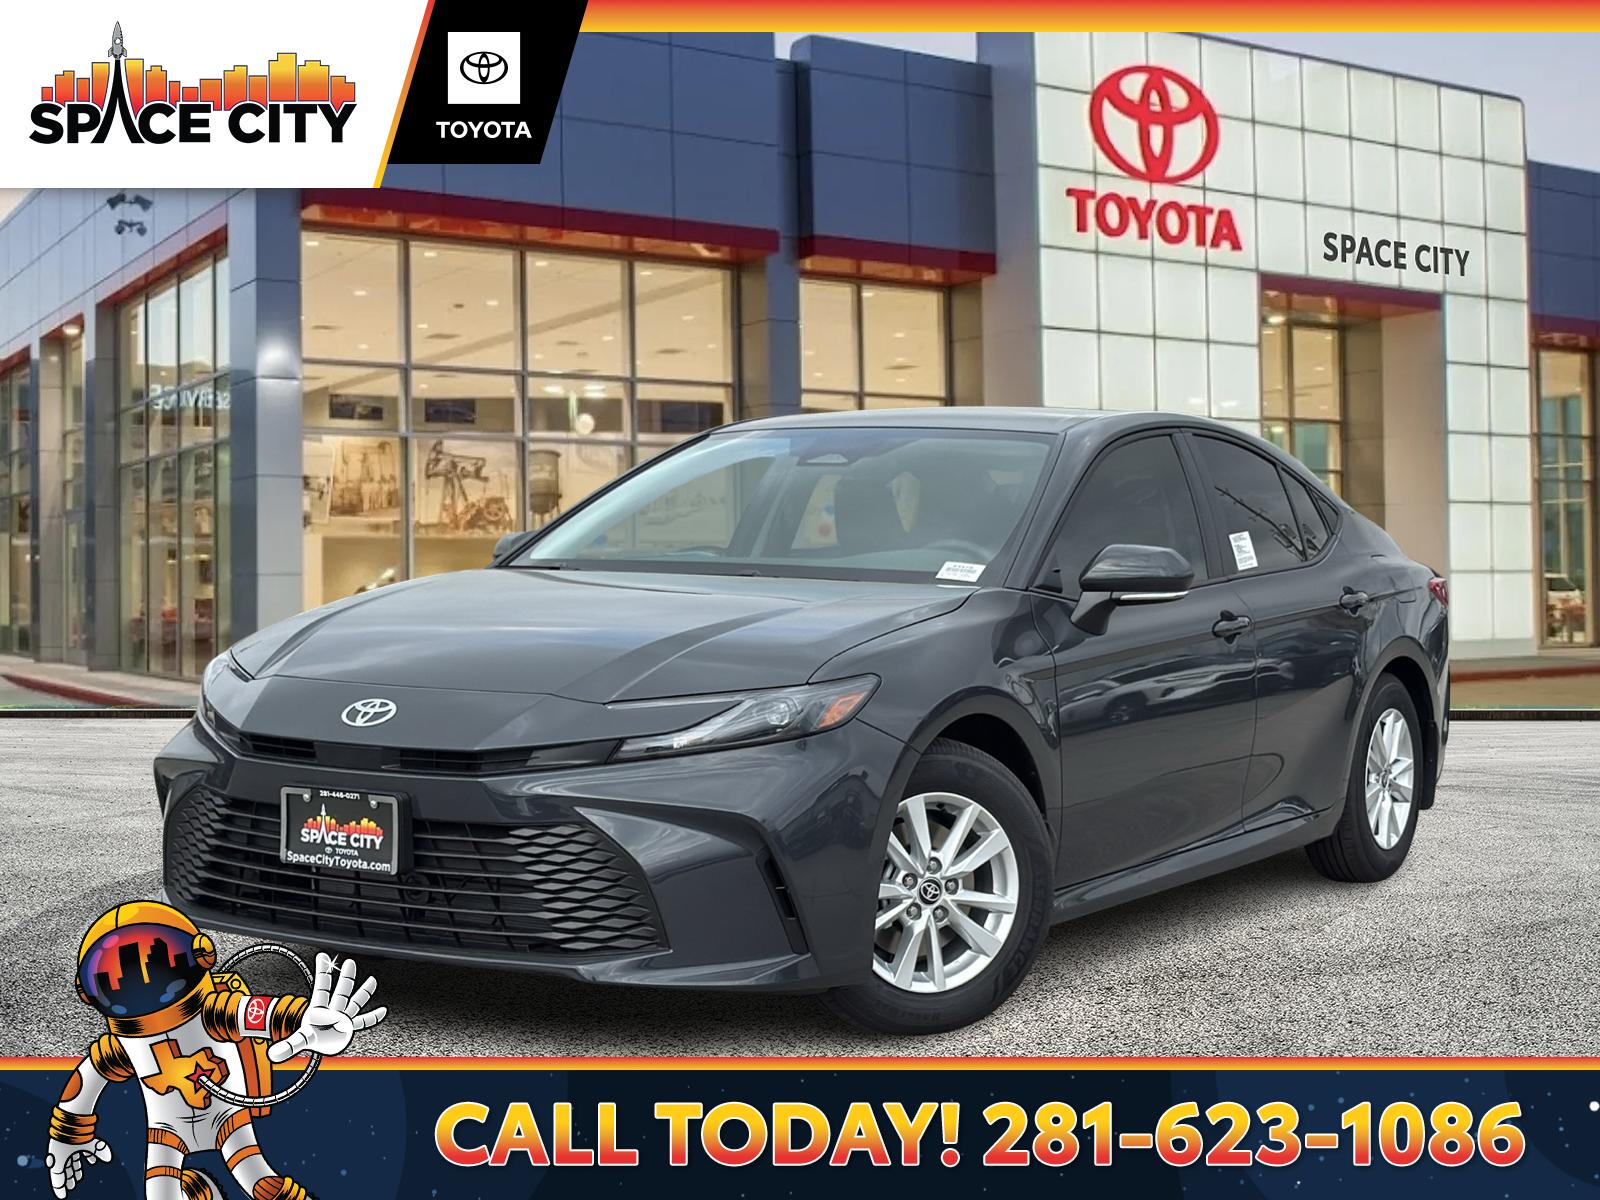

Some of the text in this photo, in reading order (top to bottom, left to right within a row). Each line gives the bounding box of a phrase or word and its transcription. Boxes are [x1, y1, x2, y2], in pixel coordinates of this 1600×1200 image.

[1066, 188, 1242, 251] TOYOTA
[1323, 231, 1470, 277] SPACE CITY
[300, 823, 384, 850] SPACE CITY
[286, 850, 391, 872] SpaceCityToyota.com
[335, 847, 359, 857] TOYOTA
